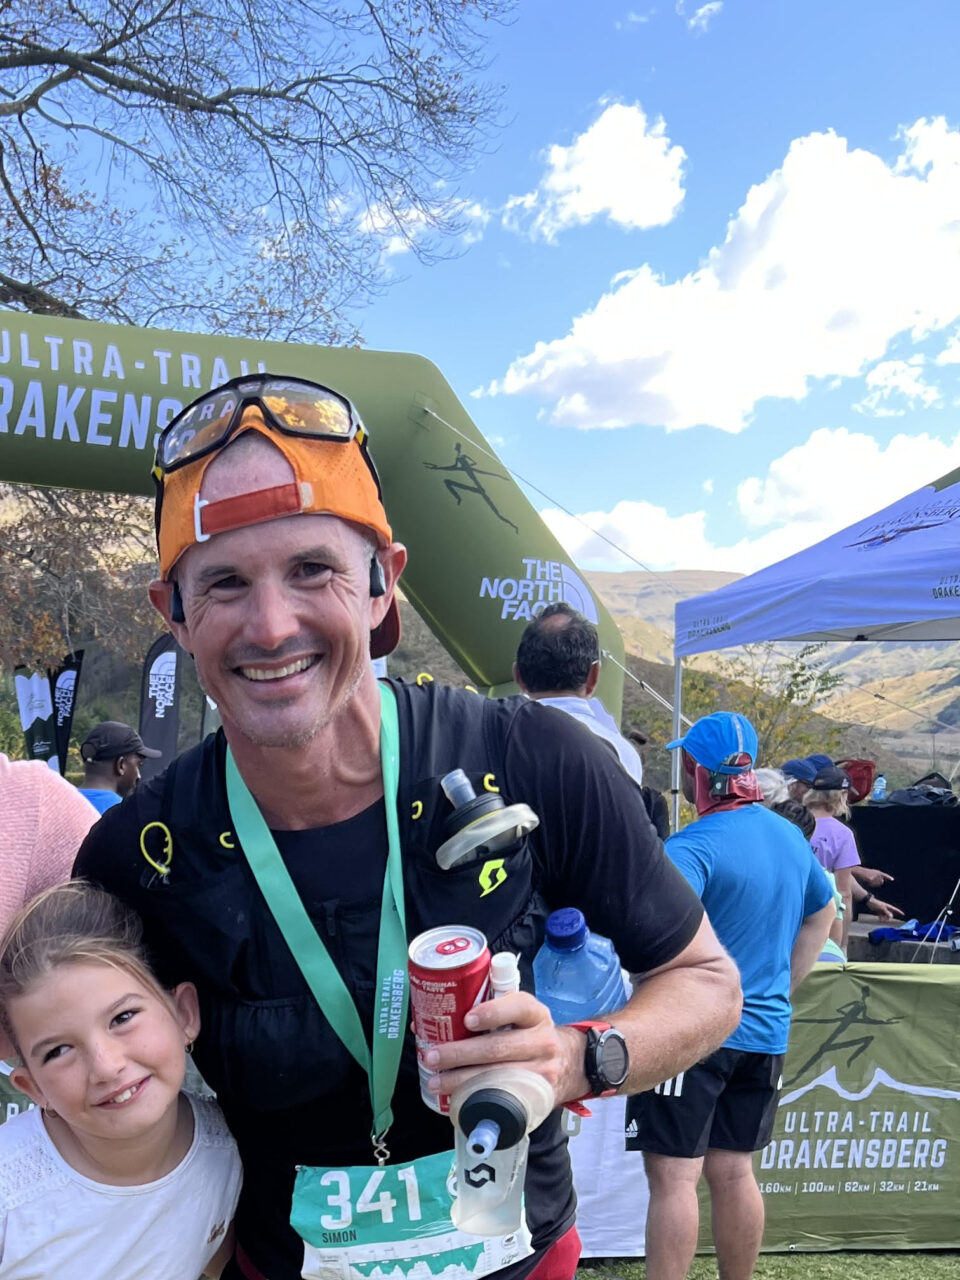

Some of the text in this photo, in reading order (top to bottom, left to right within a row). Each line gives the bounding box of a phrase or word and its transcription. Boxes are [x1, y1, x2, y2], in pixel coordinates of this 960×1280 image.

[521, 558, 562, 582] THE
[479, 577, 562, 602] NORTH
[501, 599, 556, 621] FAC
[149, 674, 158, 698] THE
[155, 674, 166, 718] NORTH
[165, 675, 175, 706] FACE
[379, 976, 392, 1034] ULTRA-TRAIL
[387, 968, 406, 1039] DRAKENSBERG
[784, 1111, 932, 1133] ULTRA-TRAIL
[760, 1138, 948, 1169] DRAKENSBERG
[320, 1165, 422, 1231] 341
[322, 1230, 357, 1244] SIMON
